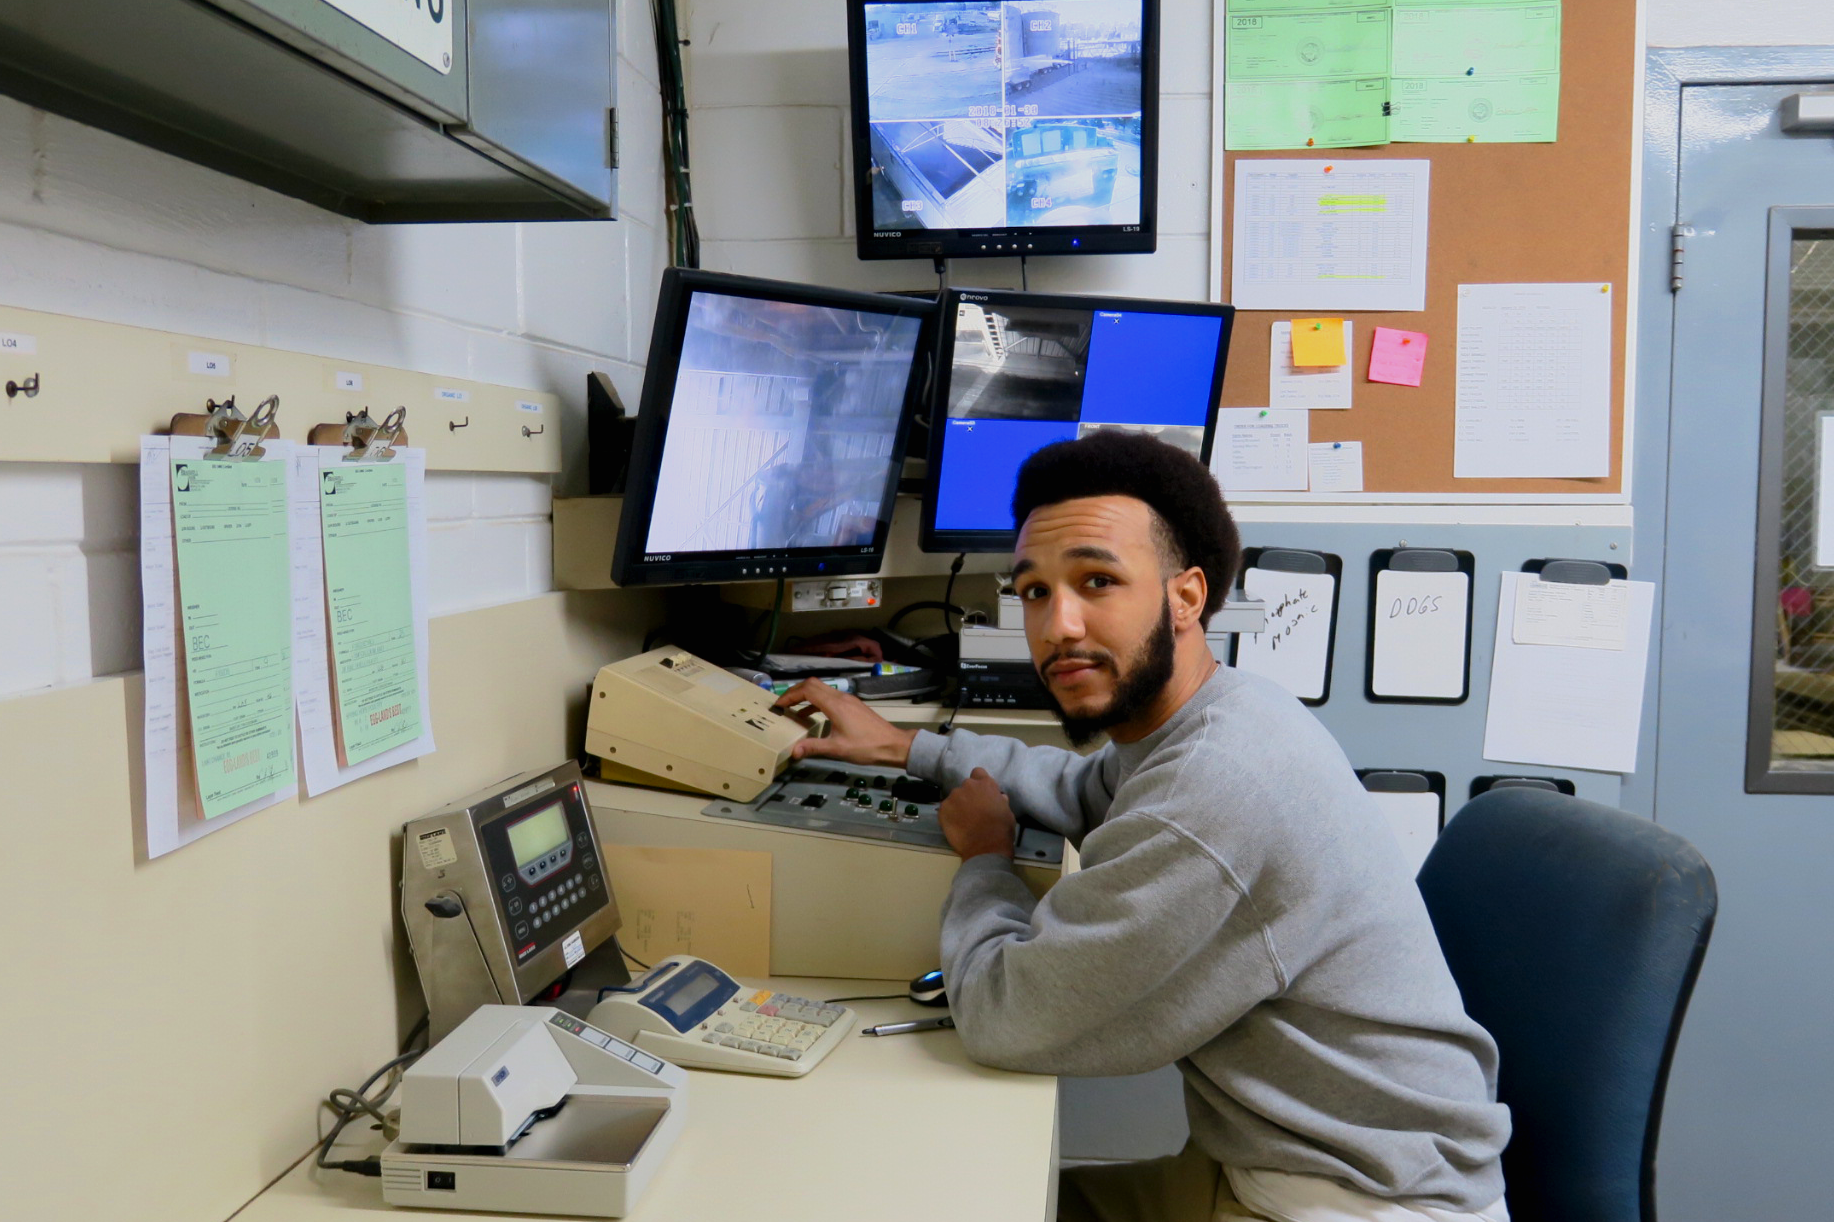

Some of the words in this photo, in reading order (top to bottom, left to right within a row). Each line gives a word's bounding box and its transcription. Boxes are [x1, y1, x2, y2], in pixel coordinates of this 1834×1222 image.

[1030, 20, 1052, 32] CH2
[1236, 17, 1258, 26] 2018
[896, 22, 918, 35] CH1
[1404, 82, 1424, 90] 2018
[643, 554, 672, 562] NUVICO
